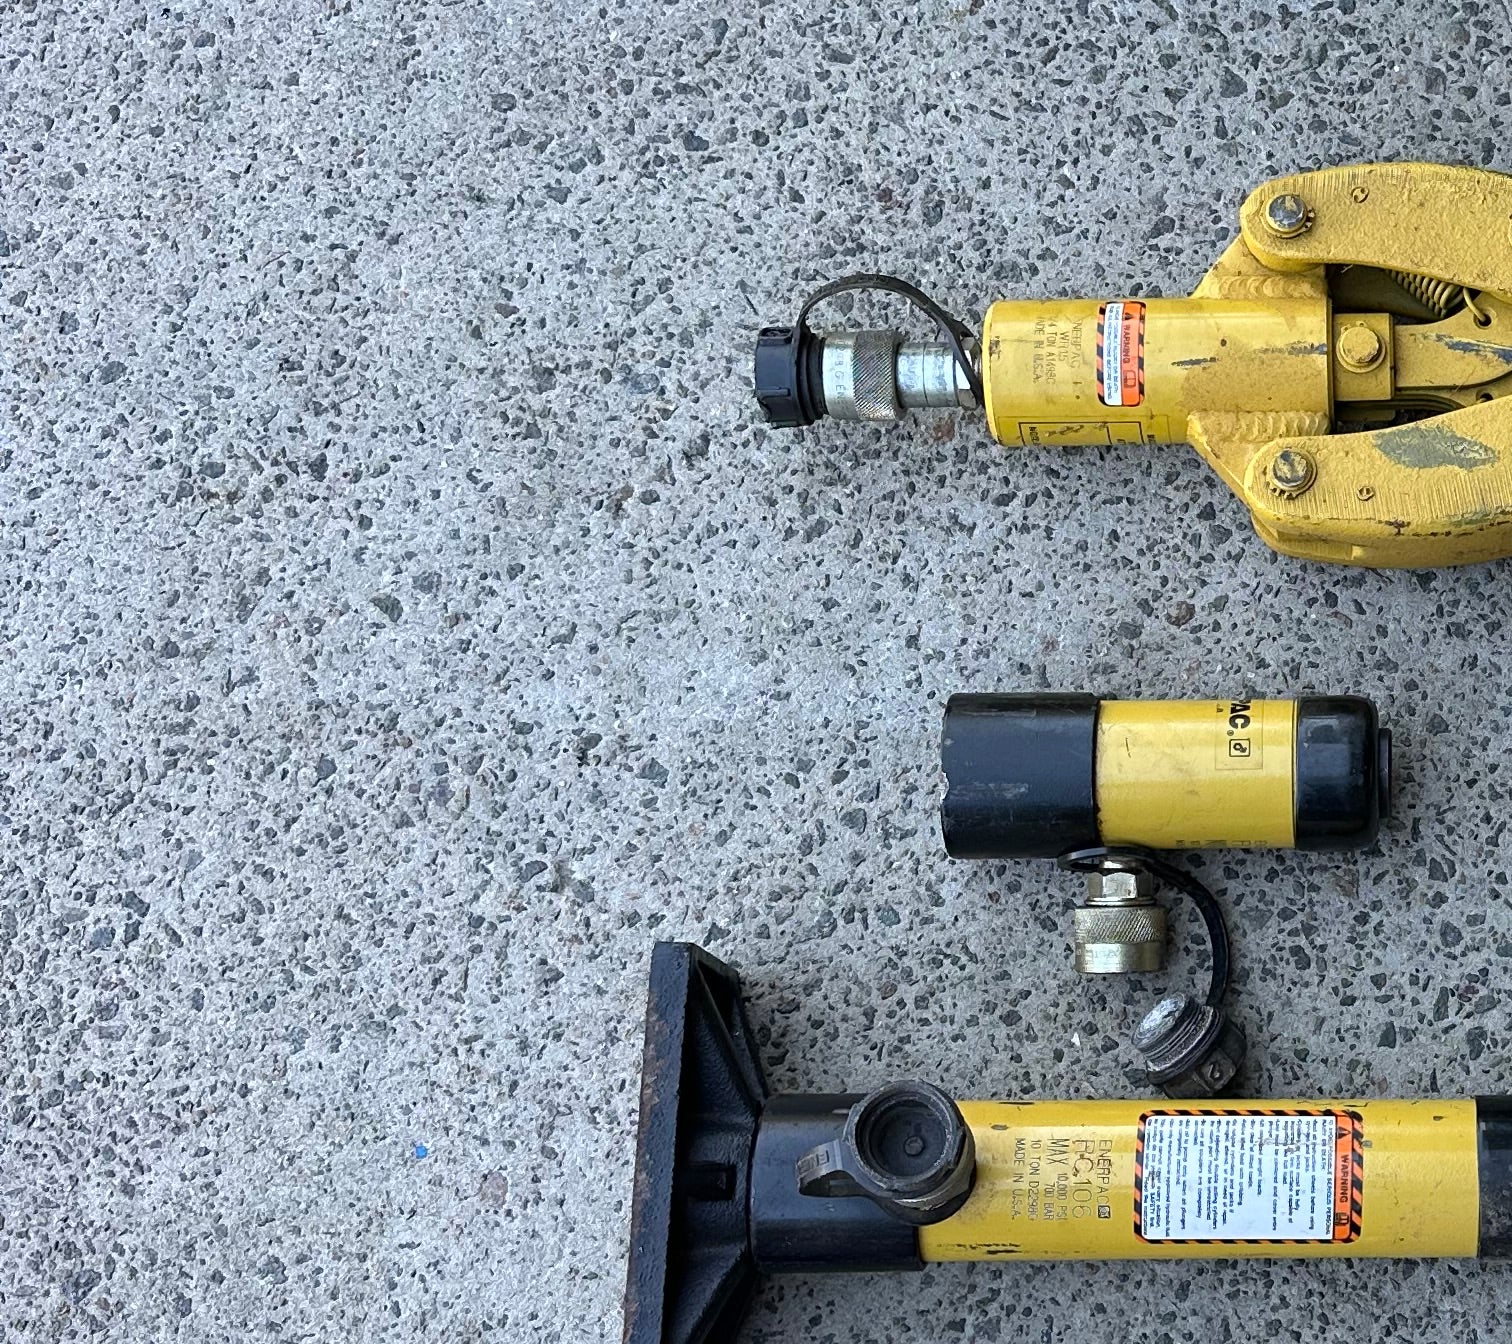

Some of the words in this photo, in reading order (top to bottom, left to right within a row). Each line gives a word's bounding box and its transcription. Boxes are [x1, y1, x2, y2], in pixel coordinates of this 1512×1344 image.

[1014, 1138, 1025, 1166] MADE
[1030, 1139, 1042, 1149] 10
[1046, 1138, 1070, 1165] MAX
[1029, 1156, 1041, 1175] TON
[1097, 1139, 1112, 1204] ENERPAC
[1013, 1172, 1024, 1183] IN
[1339, 1154, 1350, 1204] WARNING
[1044, 1183, 1055, 1198] 700
